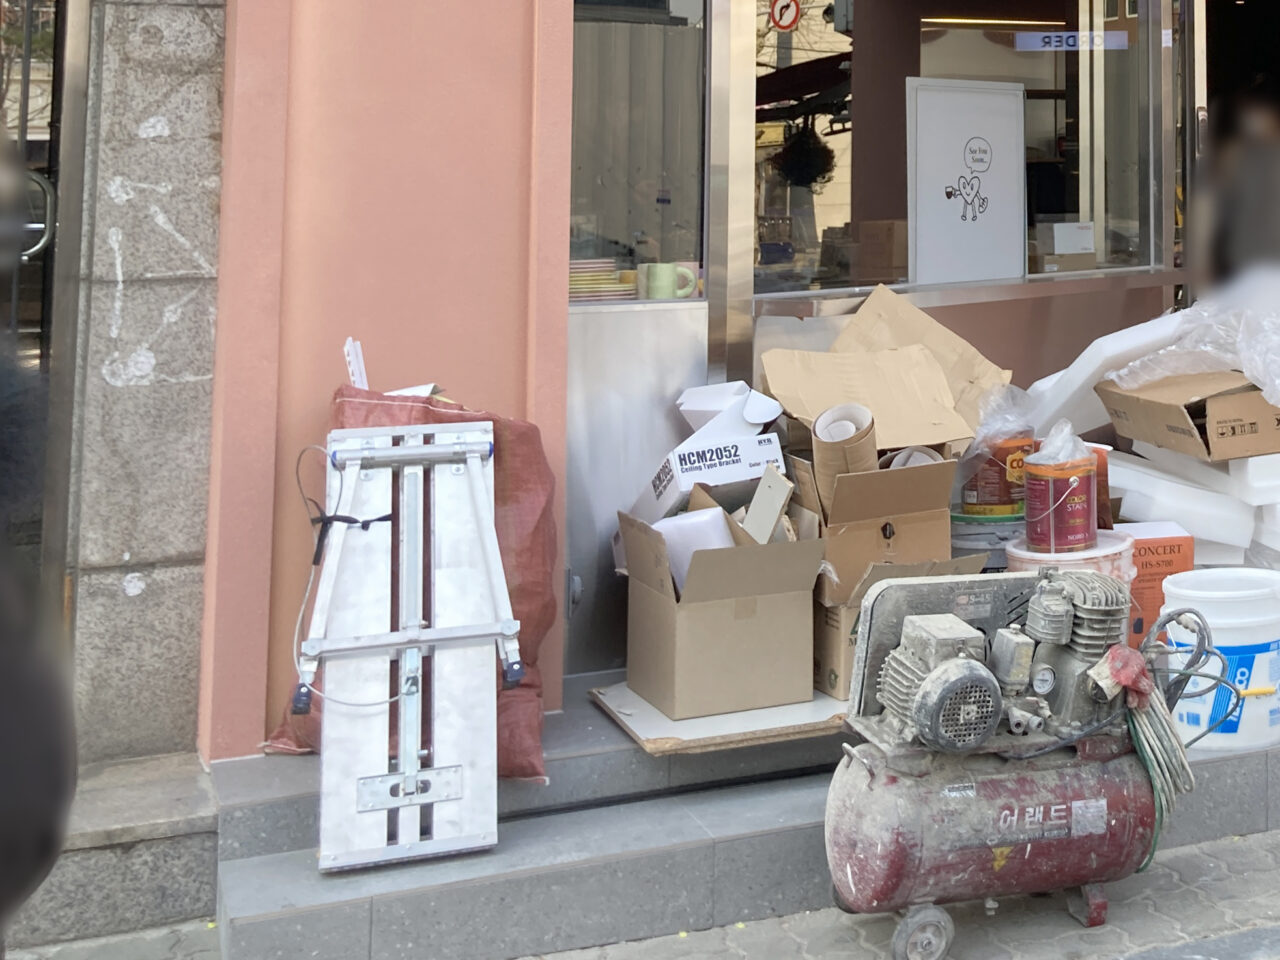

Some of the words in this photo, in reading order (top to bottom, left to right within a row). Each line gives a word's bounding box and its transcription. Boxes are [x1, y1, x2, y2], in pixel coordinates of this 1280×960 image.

[678, 444, 740, 467] HCM2052
[680, 464, 702, 474] Ceiling
[703, 462, 718, 470] Type
[719, 457, 742, 468] Bracket
[1132, 544, 1183, 558] CONCERT
